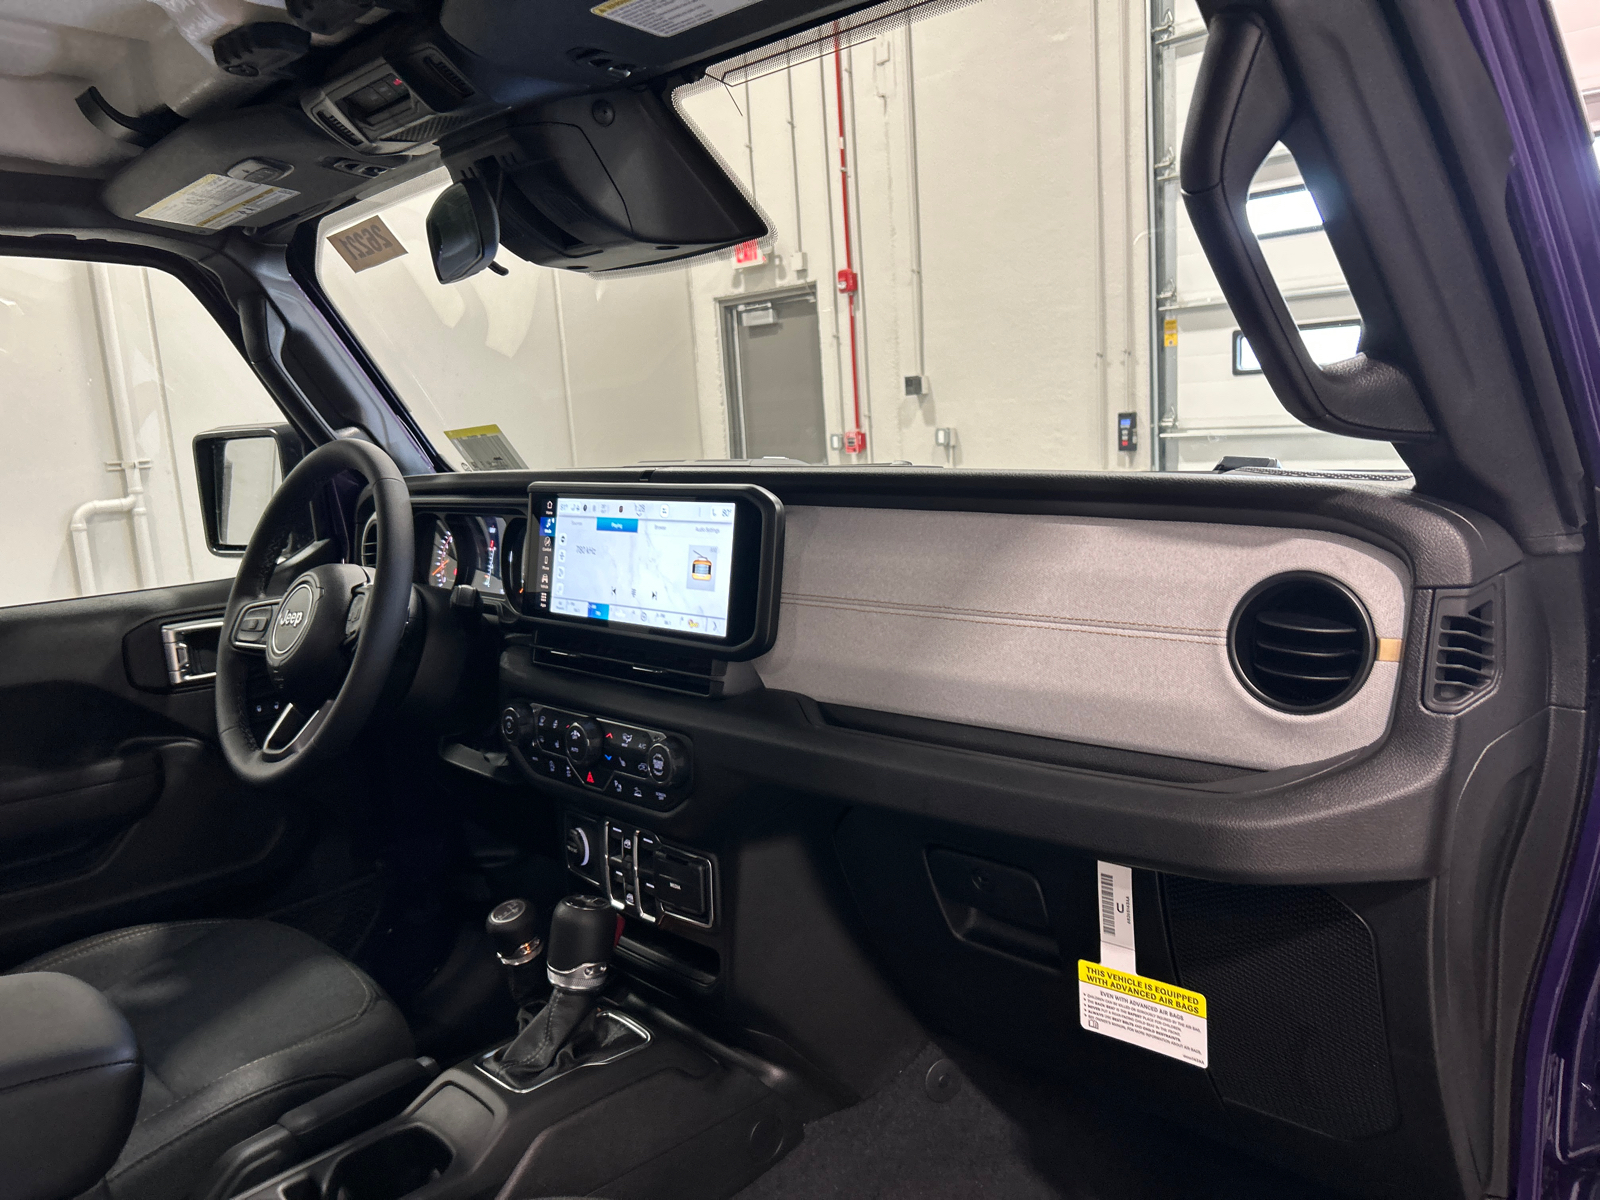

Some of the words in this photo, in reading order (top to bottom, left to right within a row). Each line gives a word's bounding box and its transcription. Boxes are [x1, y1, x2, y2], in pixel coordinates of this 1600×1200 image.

[280, 610, 303, 627] Jeep
[1116, 902, 1124, 914] U
[1086, 966, 1105, 978] THIS
[1107, 972, 1143, 989] VEHICLE
[1145, 983, 1153, 992] IS
[1155, 986, 1199, 1005] EQUIPPED
[1087, 974, 1108, 986] WITH
[1111, 981, 1157, 1001] ADVANCED
[1159, 996, 1173, 1006] AIR
[1176, 1001, 1199, 1014] BAGS
[1100, 991, 1114, 999] EVEN
[1115, 995, 1128, 1004] WITH
[1130, 1000, 1158, 1013] ADVANCED
